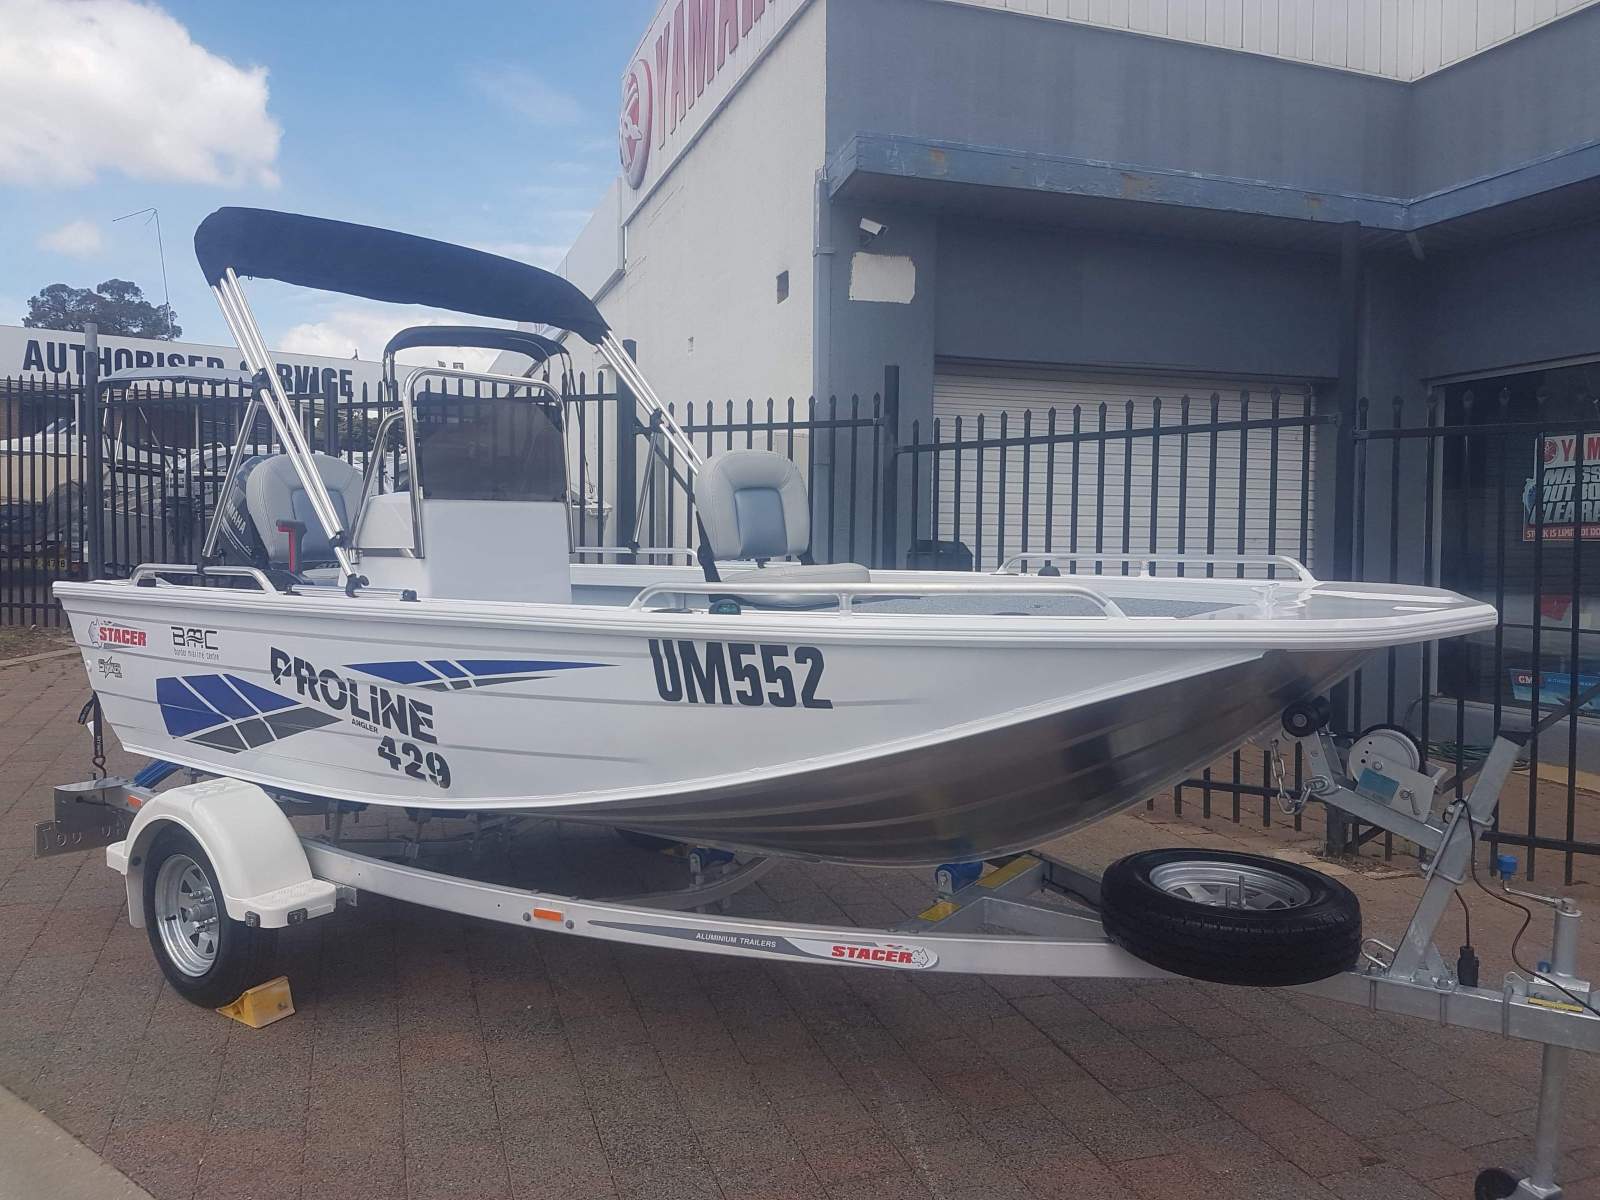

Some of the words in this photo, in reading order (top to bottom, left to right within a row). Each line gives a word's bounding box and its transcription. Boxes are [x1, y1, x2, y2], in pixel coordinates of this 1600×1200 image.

[655, 0, 766, 150] YAMA
[1562, 437, 1600, 462] YM
[99, 627, 147, 646] STACER
[171, 626, 219, 650] BMC
[648, 639, 834, 709] UM552
[270, 646, 438, 745] PROLINE
[351, 718, 378, 733] ANGLER
[377, 735, 451, 789] 429
[696, 932, 737, 944] ALUMINIUM
[740, 937, 777, 948] TRAILERS
[831, 945, 913, 964] STACER
